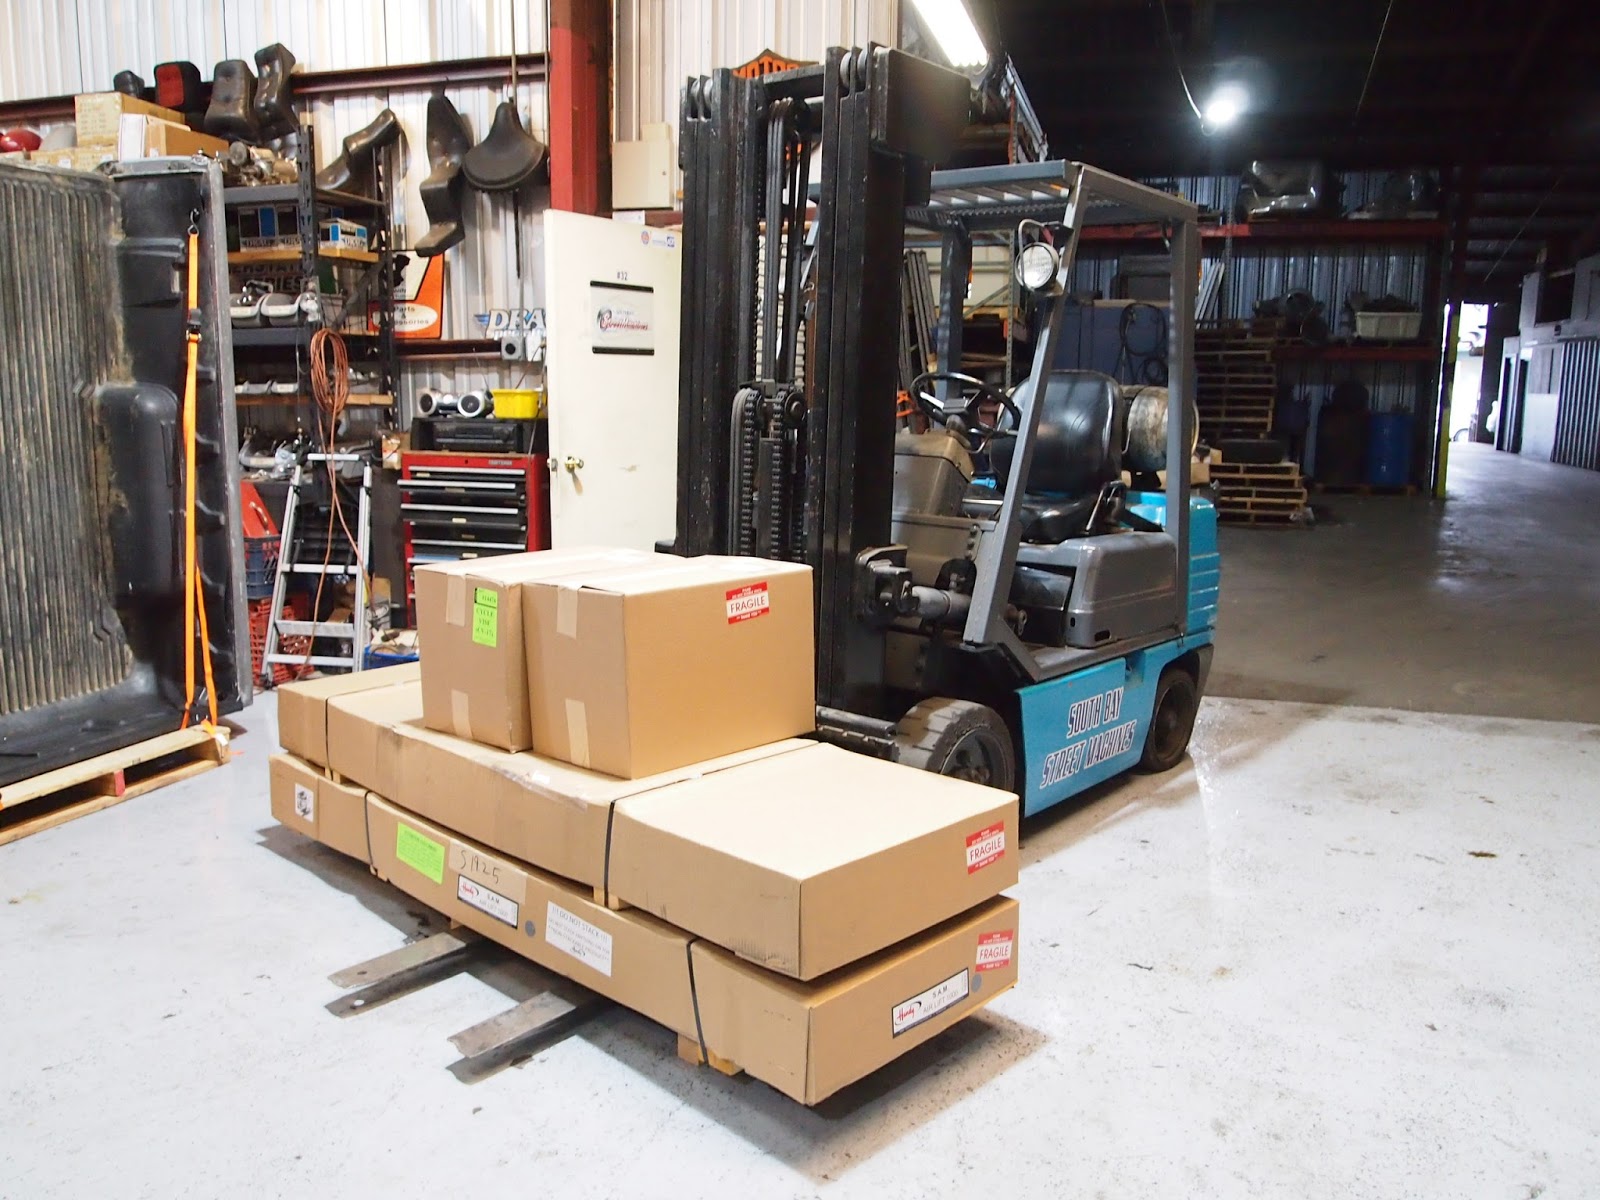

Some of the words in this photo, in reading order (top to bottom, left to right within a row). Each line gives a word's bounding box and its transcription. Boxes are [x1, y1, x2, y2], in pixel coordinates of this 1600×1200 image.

[617, 271, 628, 281] #32
[486, 308, 546, 336] DRA
[730, 596, 766, 613] FRAGILE
[1067, 694, 1103, 739] SOUTH
[1103, 686, 1124, 724] BAY
[1039, 740, 1087, 789] STREET
[1084, 719, 1137, 770] MACHINES
[970, 837, 1001, 861] FRAGILE
[980, 945, 1009, 960] FRAGILE
[896, 1006, 915, 1021] Handy
